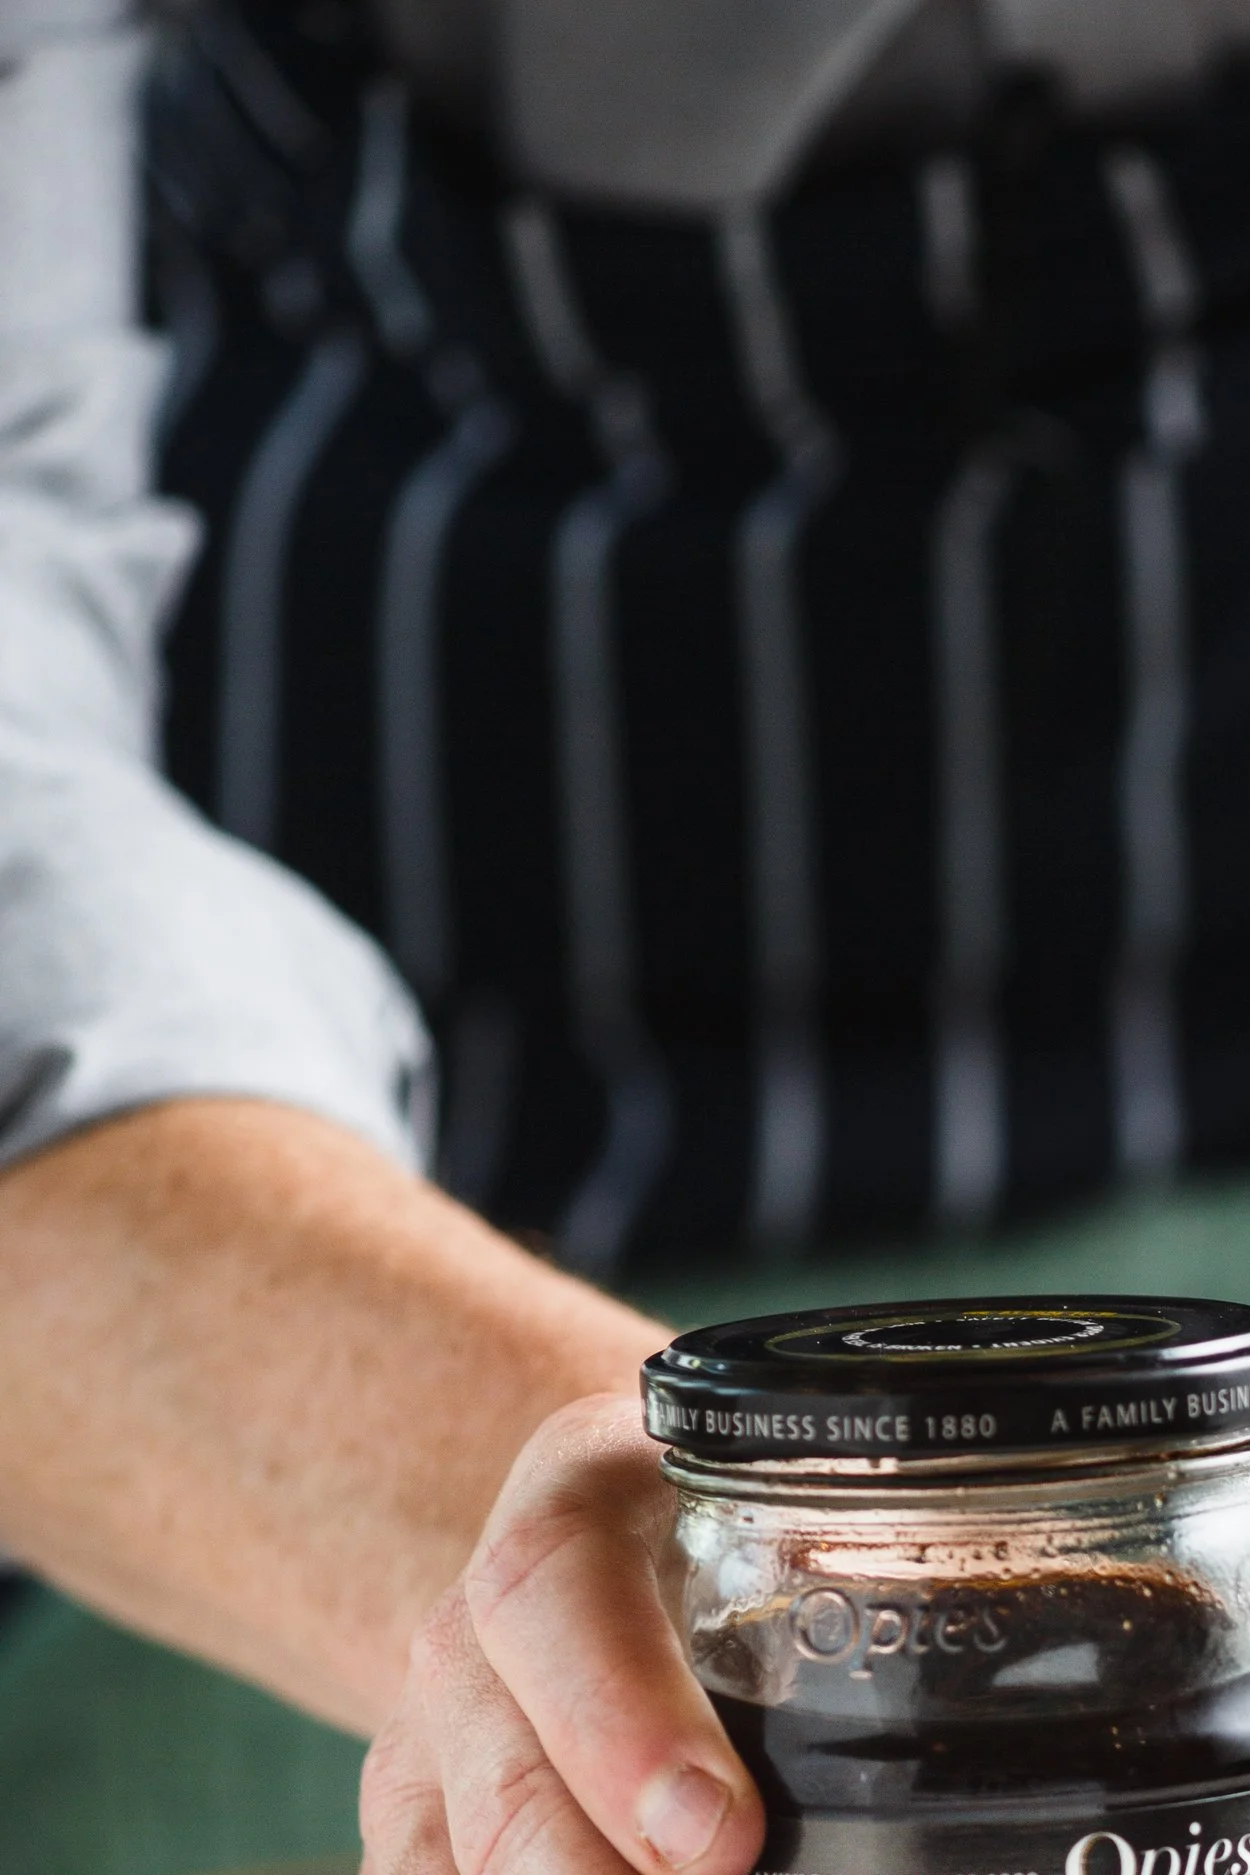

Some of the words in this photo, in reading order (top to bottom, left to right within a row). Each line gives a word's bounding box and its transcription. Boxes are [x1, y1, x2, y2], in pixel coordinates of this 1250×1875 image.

[705, 1409, 817, 1442] BUSINESS
[826, 1414, 911, 1442] SINCE
[924, 1413, 998, 1439] 1880
[1050, 1407, 1069, 1433] A
[1081, 1397, 1178, 1430] FAMILY
[789, 1586, 1010, 1680] Opies
